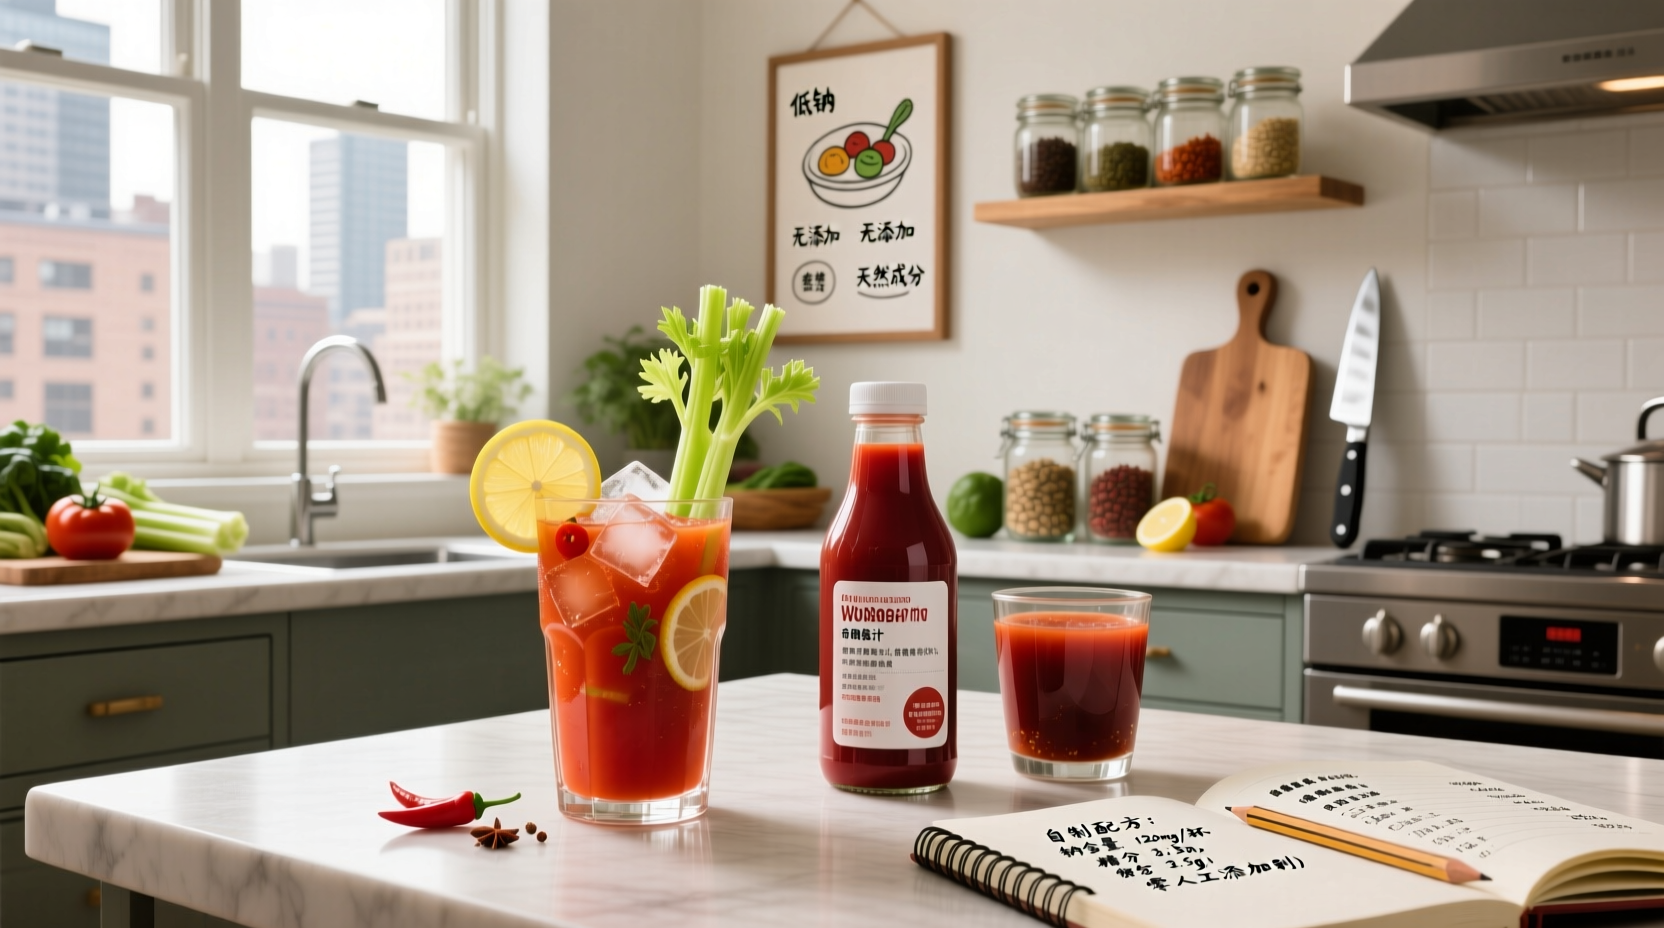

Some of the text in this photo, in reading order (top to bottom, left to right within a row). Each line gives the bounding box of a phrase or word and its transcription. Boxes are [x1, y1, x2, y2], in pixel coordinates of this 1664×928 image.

[790, 87, 836, 117] 低钠
[792, 221, 914, 247] 无添加 无添加
[857, 263, 925, 288] 天然成分
